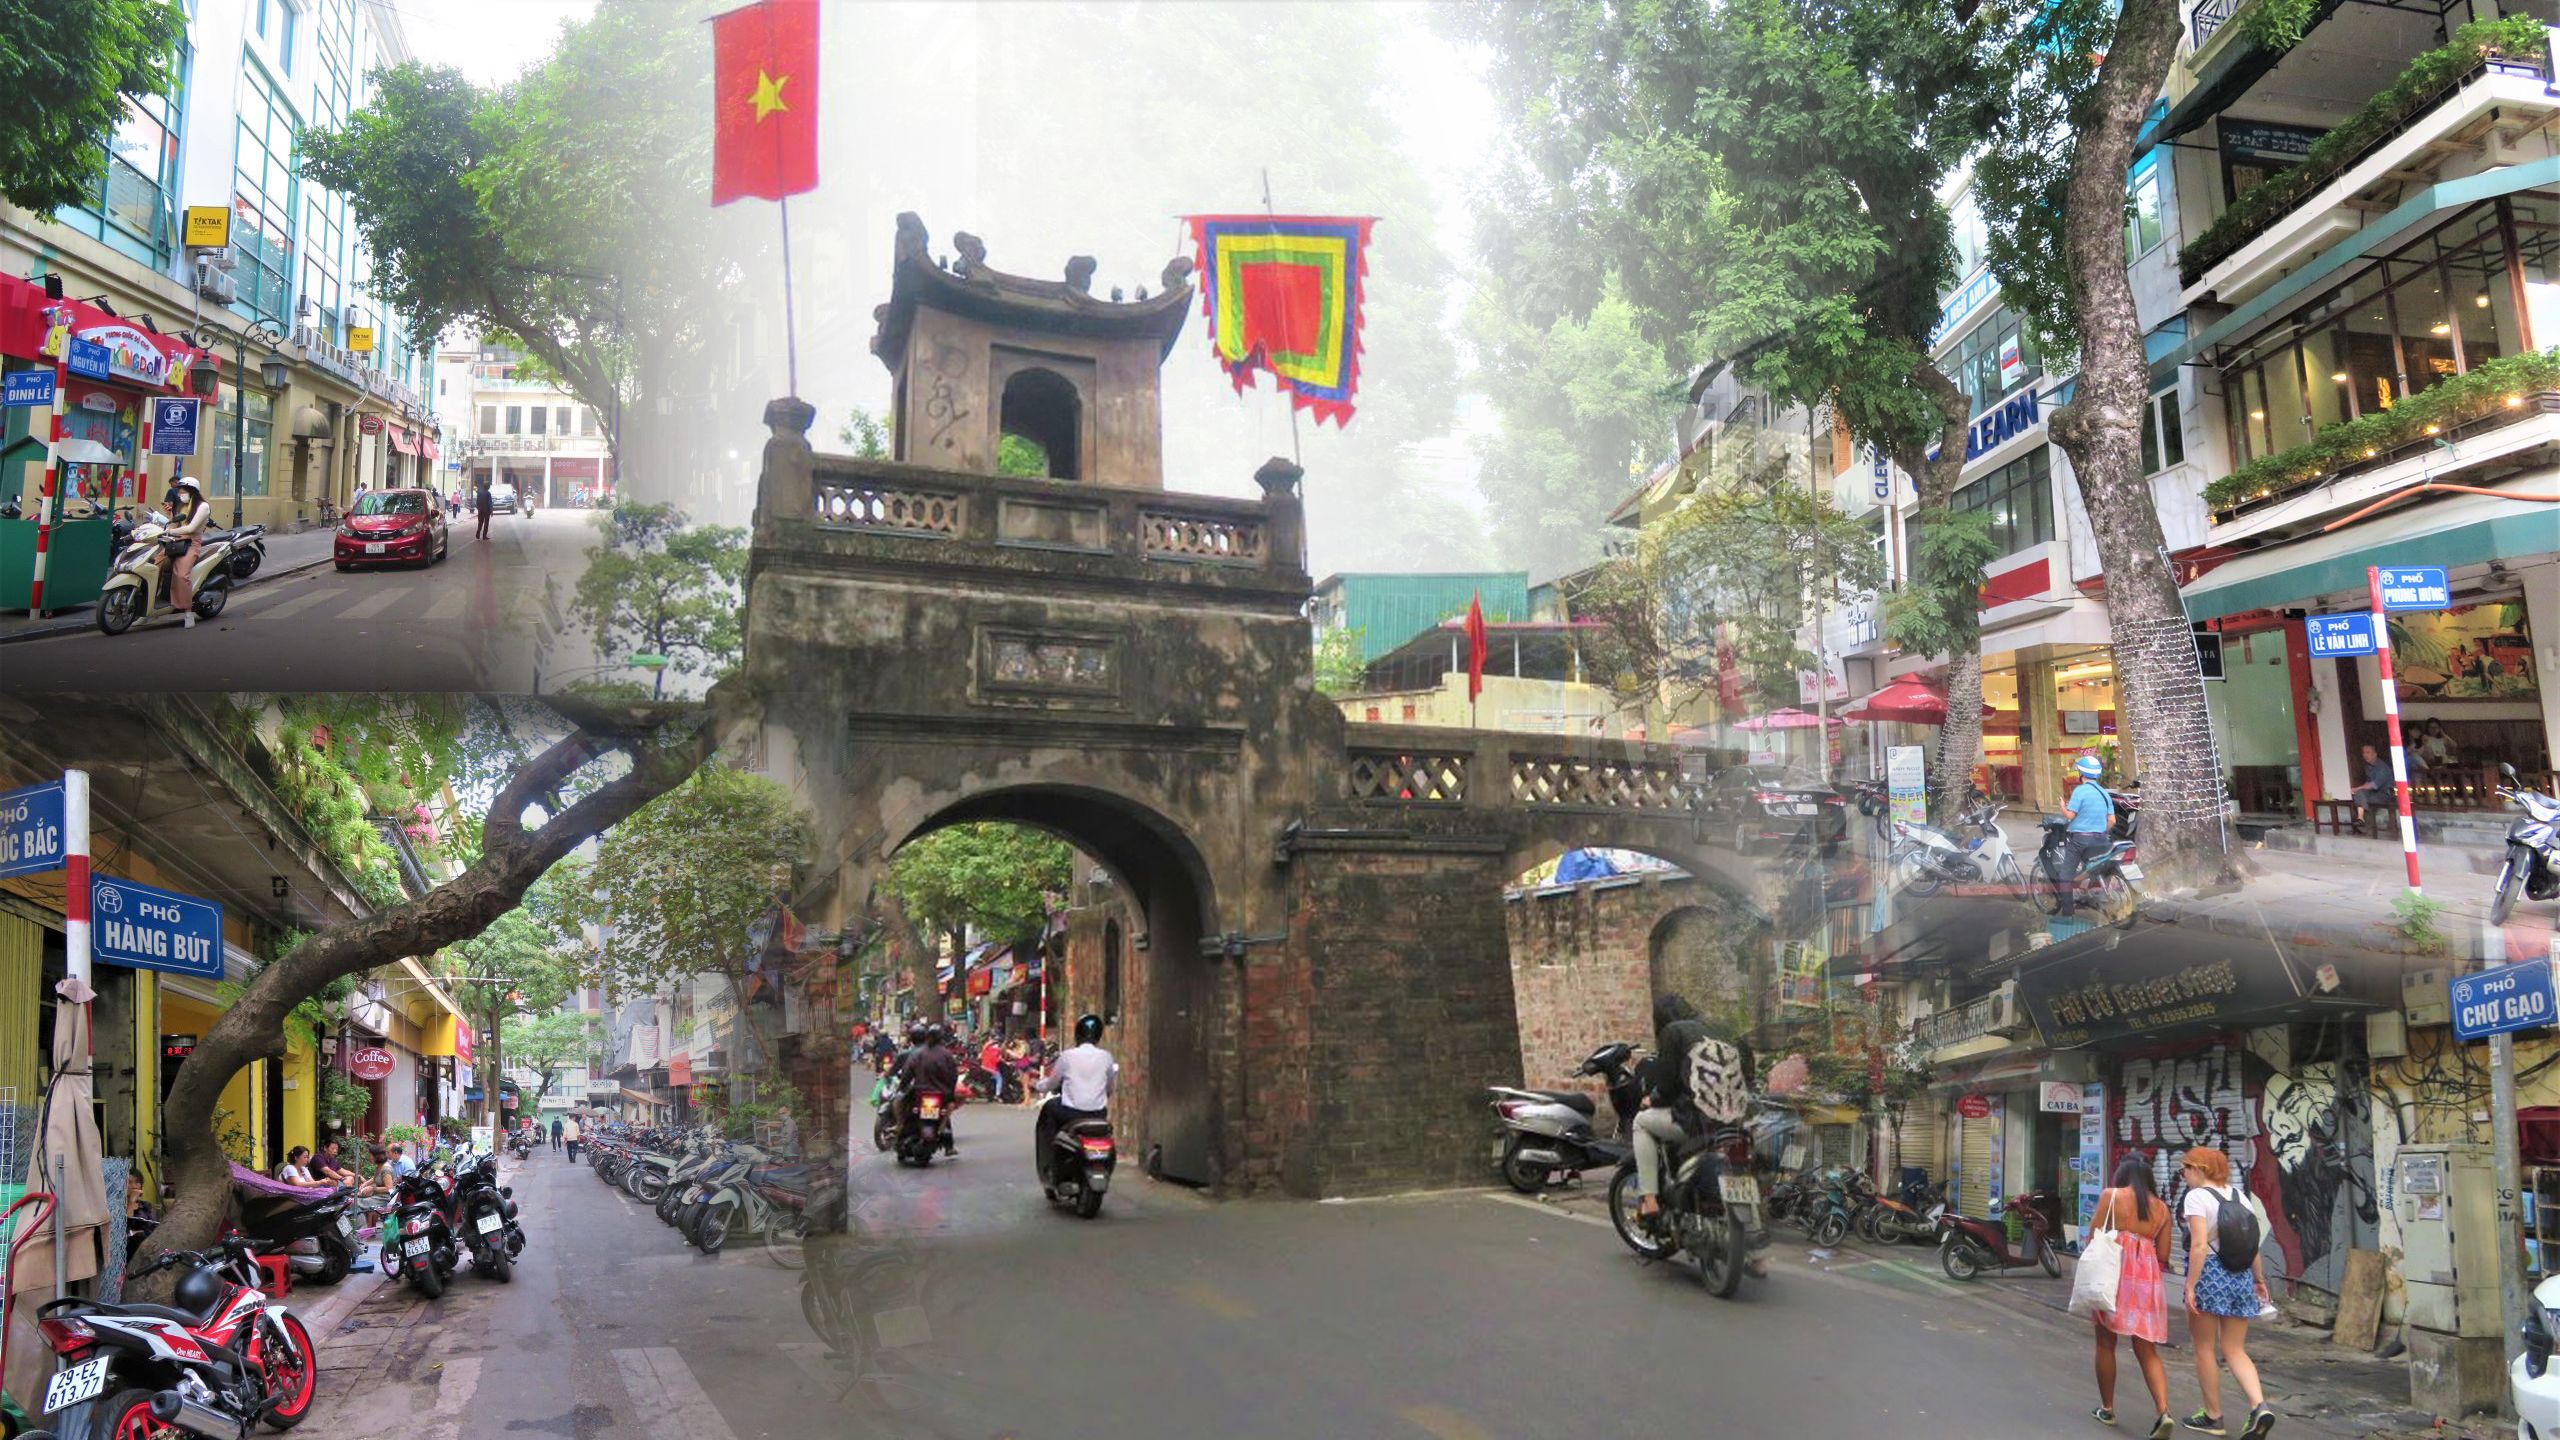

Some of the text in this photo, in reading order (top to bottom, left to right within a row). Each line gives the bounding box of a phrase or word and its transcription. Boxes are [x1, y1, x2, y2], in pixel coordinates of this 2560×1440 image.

[87, 347, 101, 356] PHỐ
[26, 375, 42, 383] PHỐ
[2401, 571, 2424, 583] PHỐ
[2384, 584, 2417, 603] PHÙNG
[2328, 618, 2350, 631] PHỐ
[2314, 632, 2369, 651] LÊ VĂN LINH
[24, 817, 58, 859] BẮC
[139, 903, 182, 923] PHỐ
[105, 916, 211, 964] HÀNG BÚT
[2483, 971, 2516, 996] PHỐ
[2462, 991, 2545, 1028] CHỢ GẠO
[355, 1050, 390, 1065] Coffee
[56, 1360, 99, 1389] 29-E2
[48, 1376, 100, 1408] 813.77
